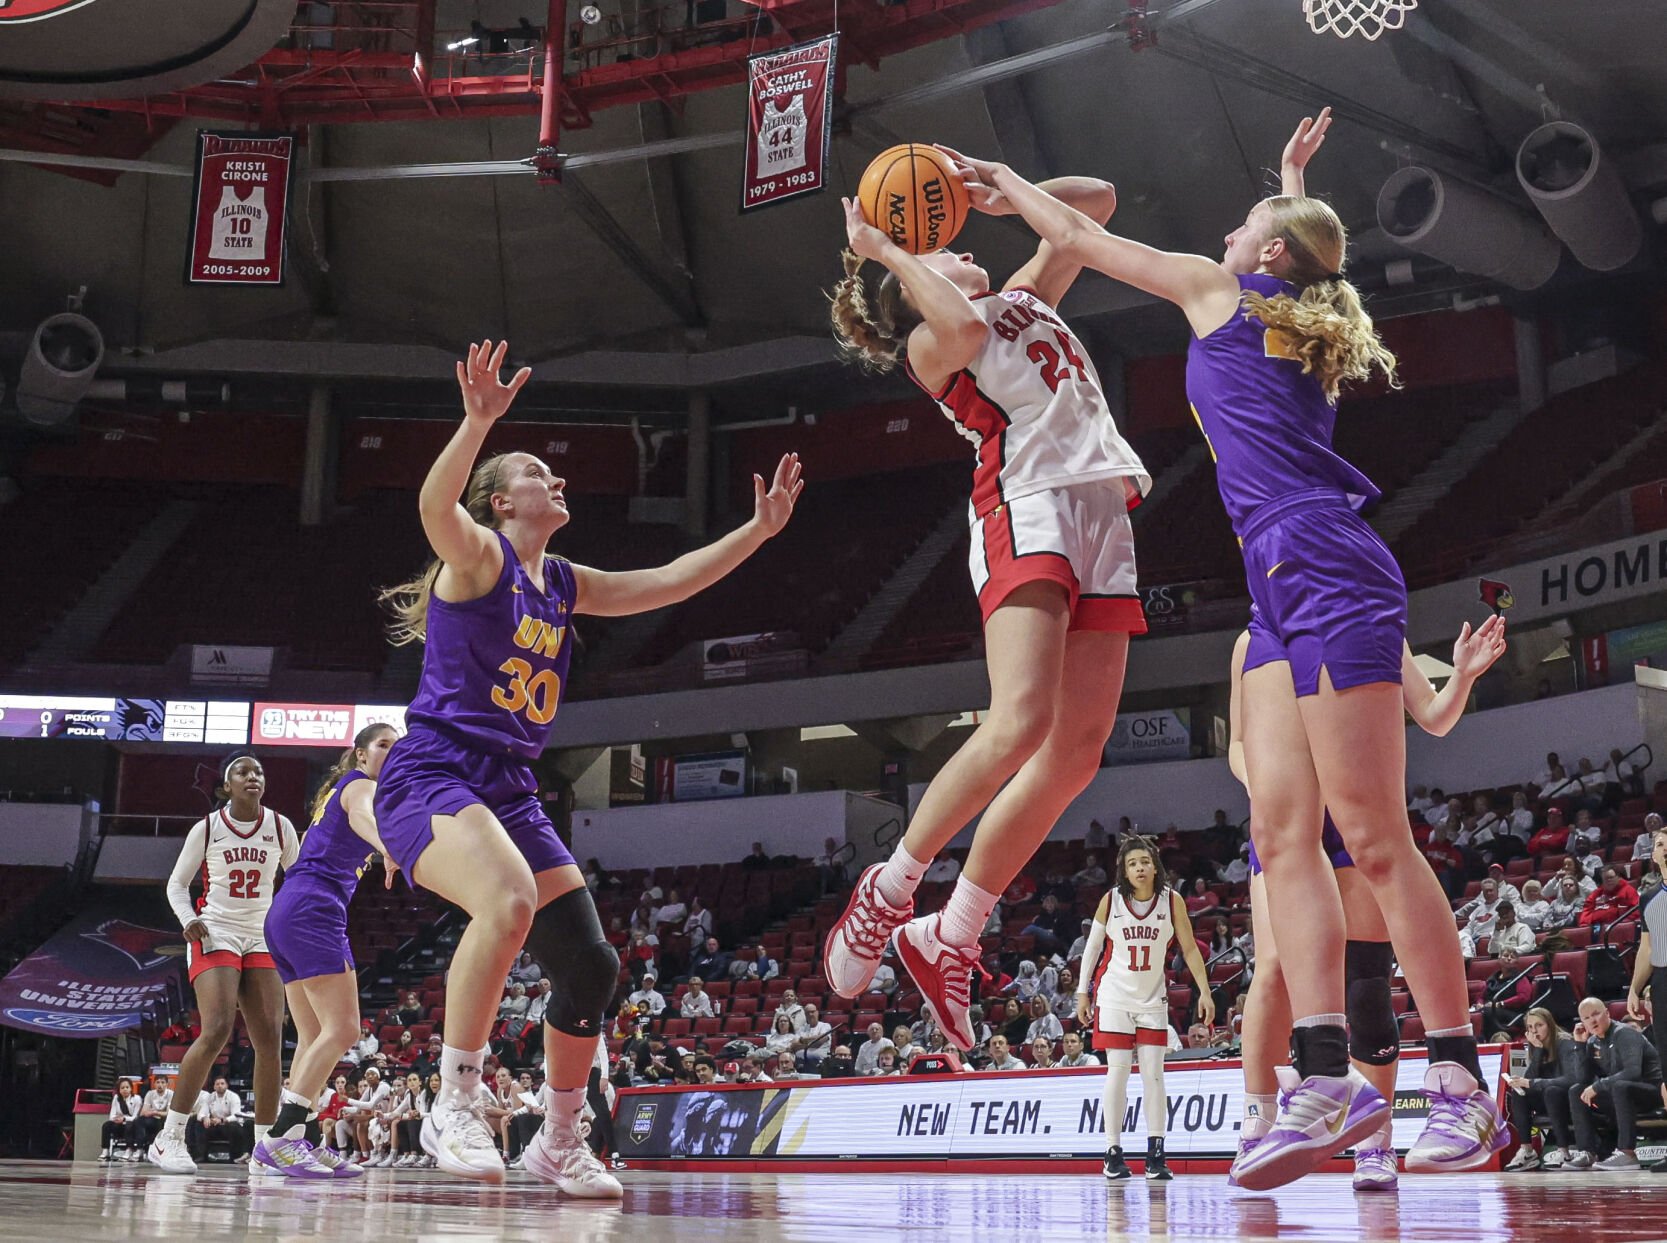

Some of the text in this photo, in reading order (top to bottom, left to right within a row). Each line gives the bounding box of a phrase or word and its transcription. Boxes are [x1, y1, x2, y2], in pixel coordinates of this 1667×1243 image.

[767, 70, 807, 88] CATHY
[759, 79, 814, 100] BOSWELL
[764, 114, 802, 134] ILLINOIS
[769, 127, 793, 147] 44
[767, 146, 794, 163] STATE
[226, 161, 265, 171] KRISTI
[221, 171, 269, 181] CIRONE
[750, 181, 776, 198] 1979
[786, 171, 815, 188] 1983
[221, 204, 262, 219] ILLINOIS
[922, 177, 947, 250] Wilson
[230, 218, 251, 234] 10
[224, 236, 254, 248] STATE
[202, 264, 271, 276] 2005-2009
[546, 441, 568, 453] 219
[490, 656, 561, 725] 30
[41, 711, 110, 724] 0 POINTS
[286, 709, 350, 722] TRY THE
[41, 724, 105, 737] 1 FOULS
[285, 720, 349, 740] NEW
[1131, 716, 1170, 738] OSF
[223, 847, 268, 865] BIRDS
[228, 869, 262, 899] 22
[1122, 925, 1160, 941] BIRDS
[1127, 945, 1151, 972] 11
[57, 980, 167, 995] ILLINOIS
[66, 990, 145, 1002] STATE
[32, 1014, 130, 1029] Ford
[1392, 1097, 1424, 1109] EARN
[637, 1112, 654, 1120] ARMY
[897, 1102, 952, 1137] NEW
[969, 1099, 1052, 1136] TEAM.
[1166, 1093, 1242, 1132] YOU.
[633, 1124, 651, 1132] GUARD
